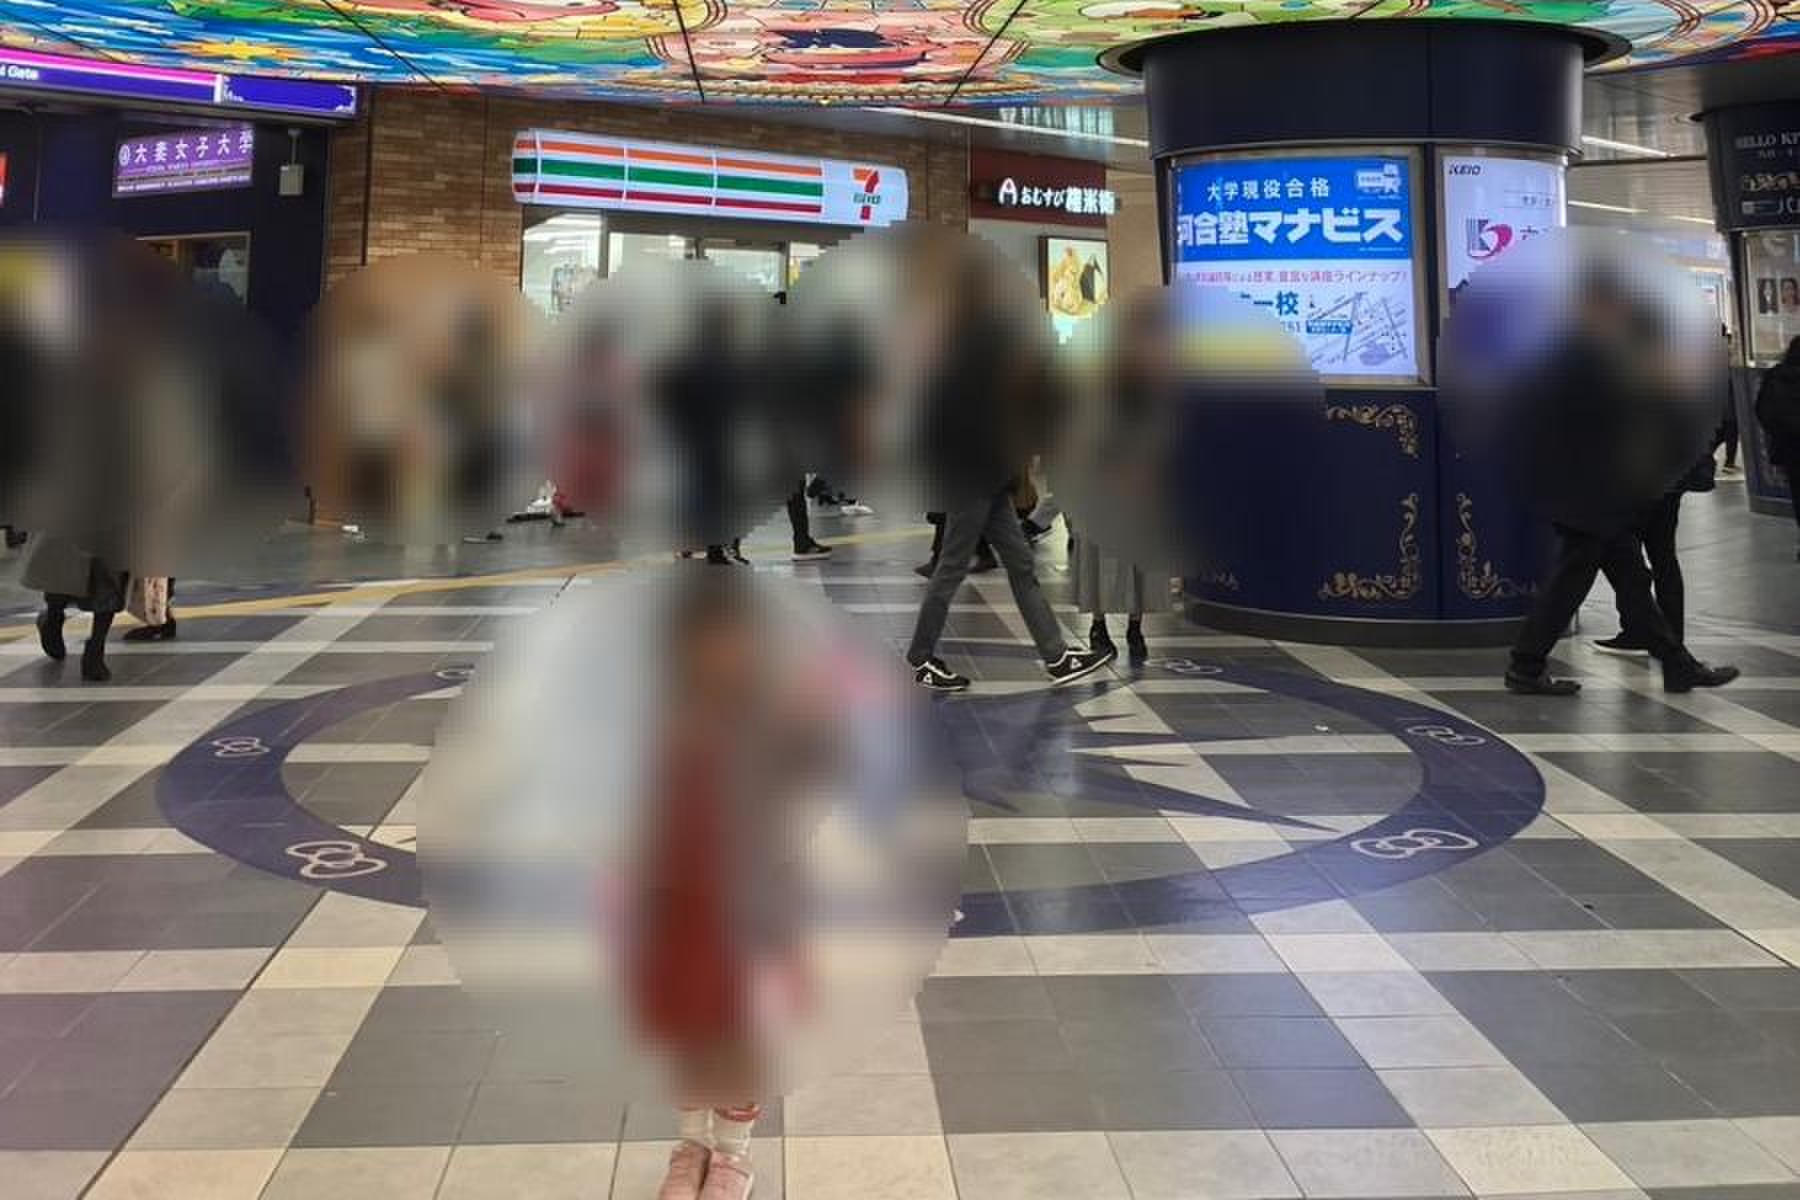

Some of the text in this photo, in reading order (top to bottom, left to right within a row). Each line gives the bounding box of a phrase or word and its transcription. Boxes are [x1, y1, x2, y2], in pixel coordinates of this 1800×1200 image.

[1448, 164, 1481, 176] KEIO
[1206, 177, 1331, 203] 大学現役合格
